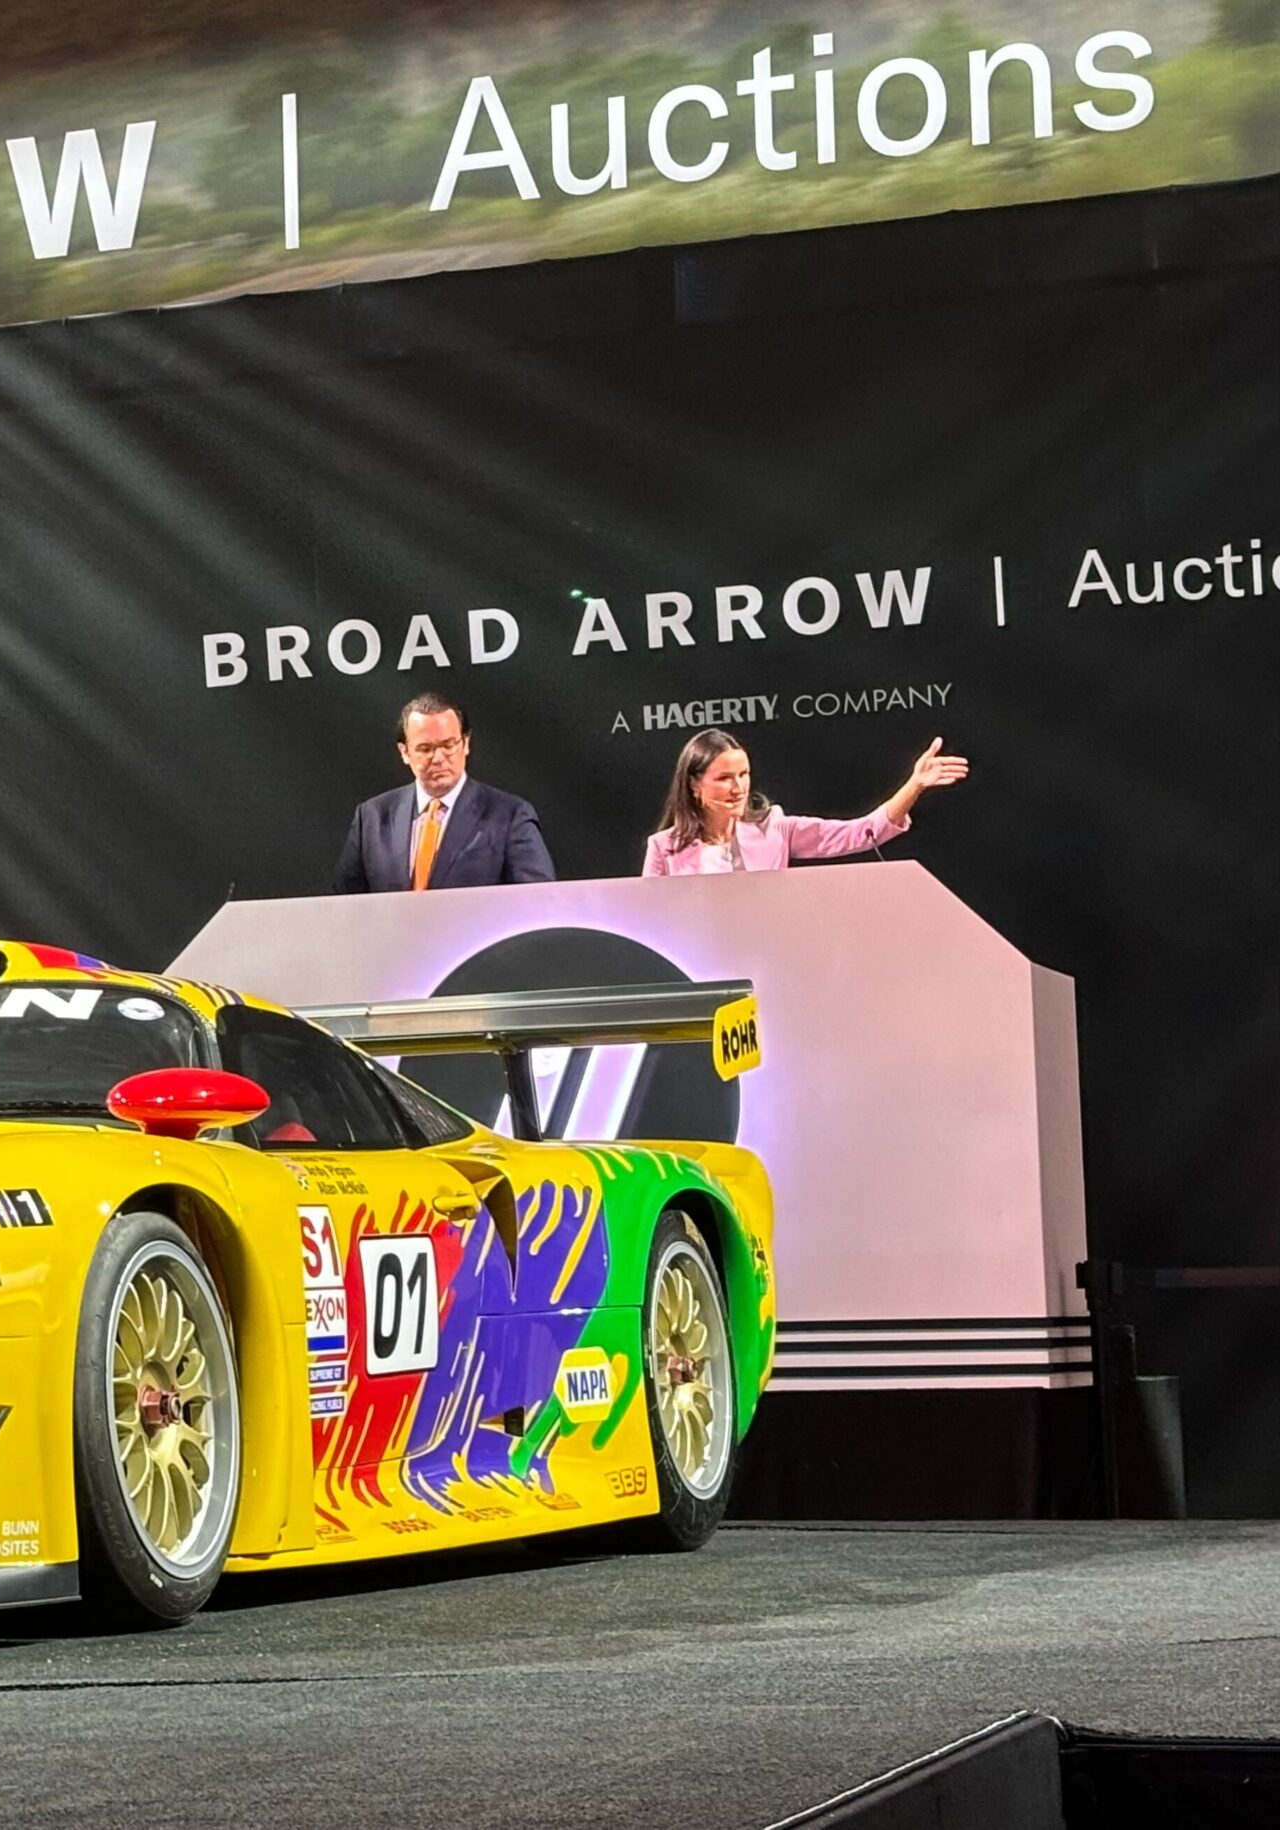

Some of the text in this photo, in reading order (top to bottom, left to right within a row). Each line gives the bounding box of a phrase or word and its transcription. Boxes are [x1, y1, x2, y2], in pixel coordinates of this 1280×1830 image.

[428, 30, 1156, 212] Auctions
[203, 538, 1280, 688] BROAD ARROW Aucti
[611, 682, 952, 734] A HAGERTY COMPANY
[721, 1018, 759, 1066] ROHR
[305, 1294, 345, 1332] EXXON
[373, 1252, 428, 1359] 01
[566, 1369, 609, 1402] NAPA
[605, 1466, 647, 1498] BBS
[2, 1520, 39, 1536] BUNN
